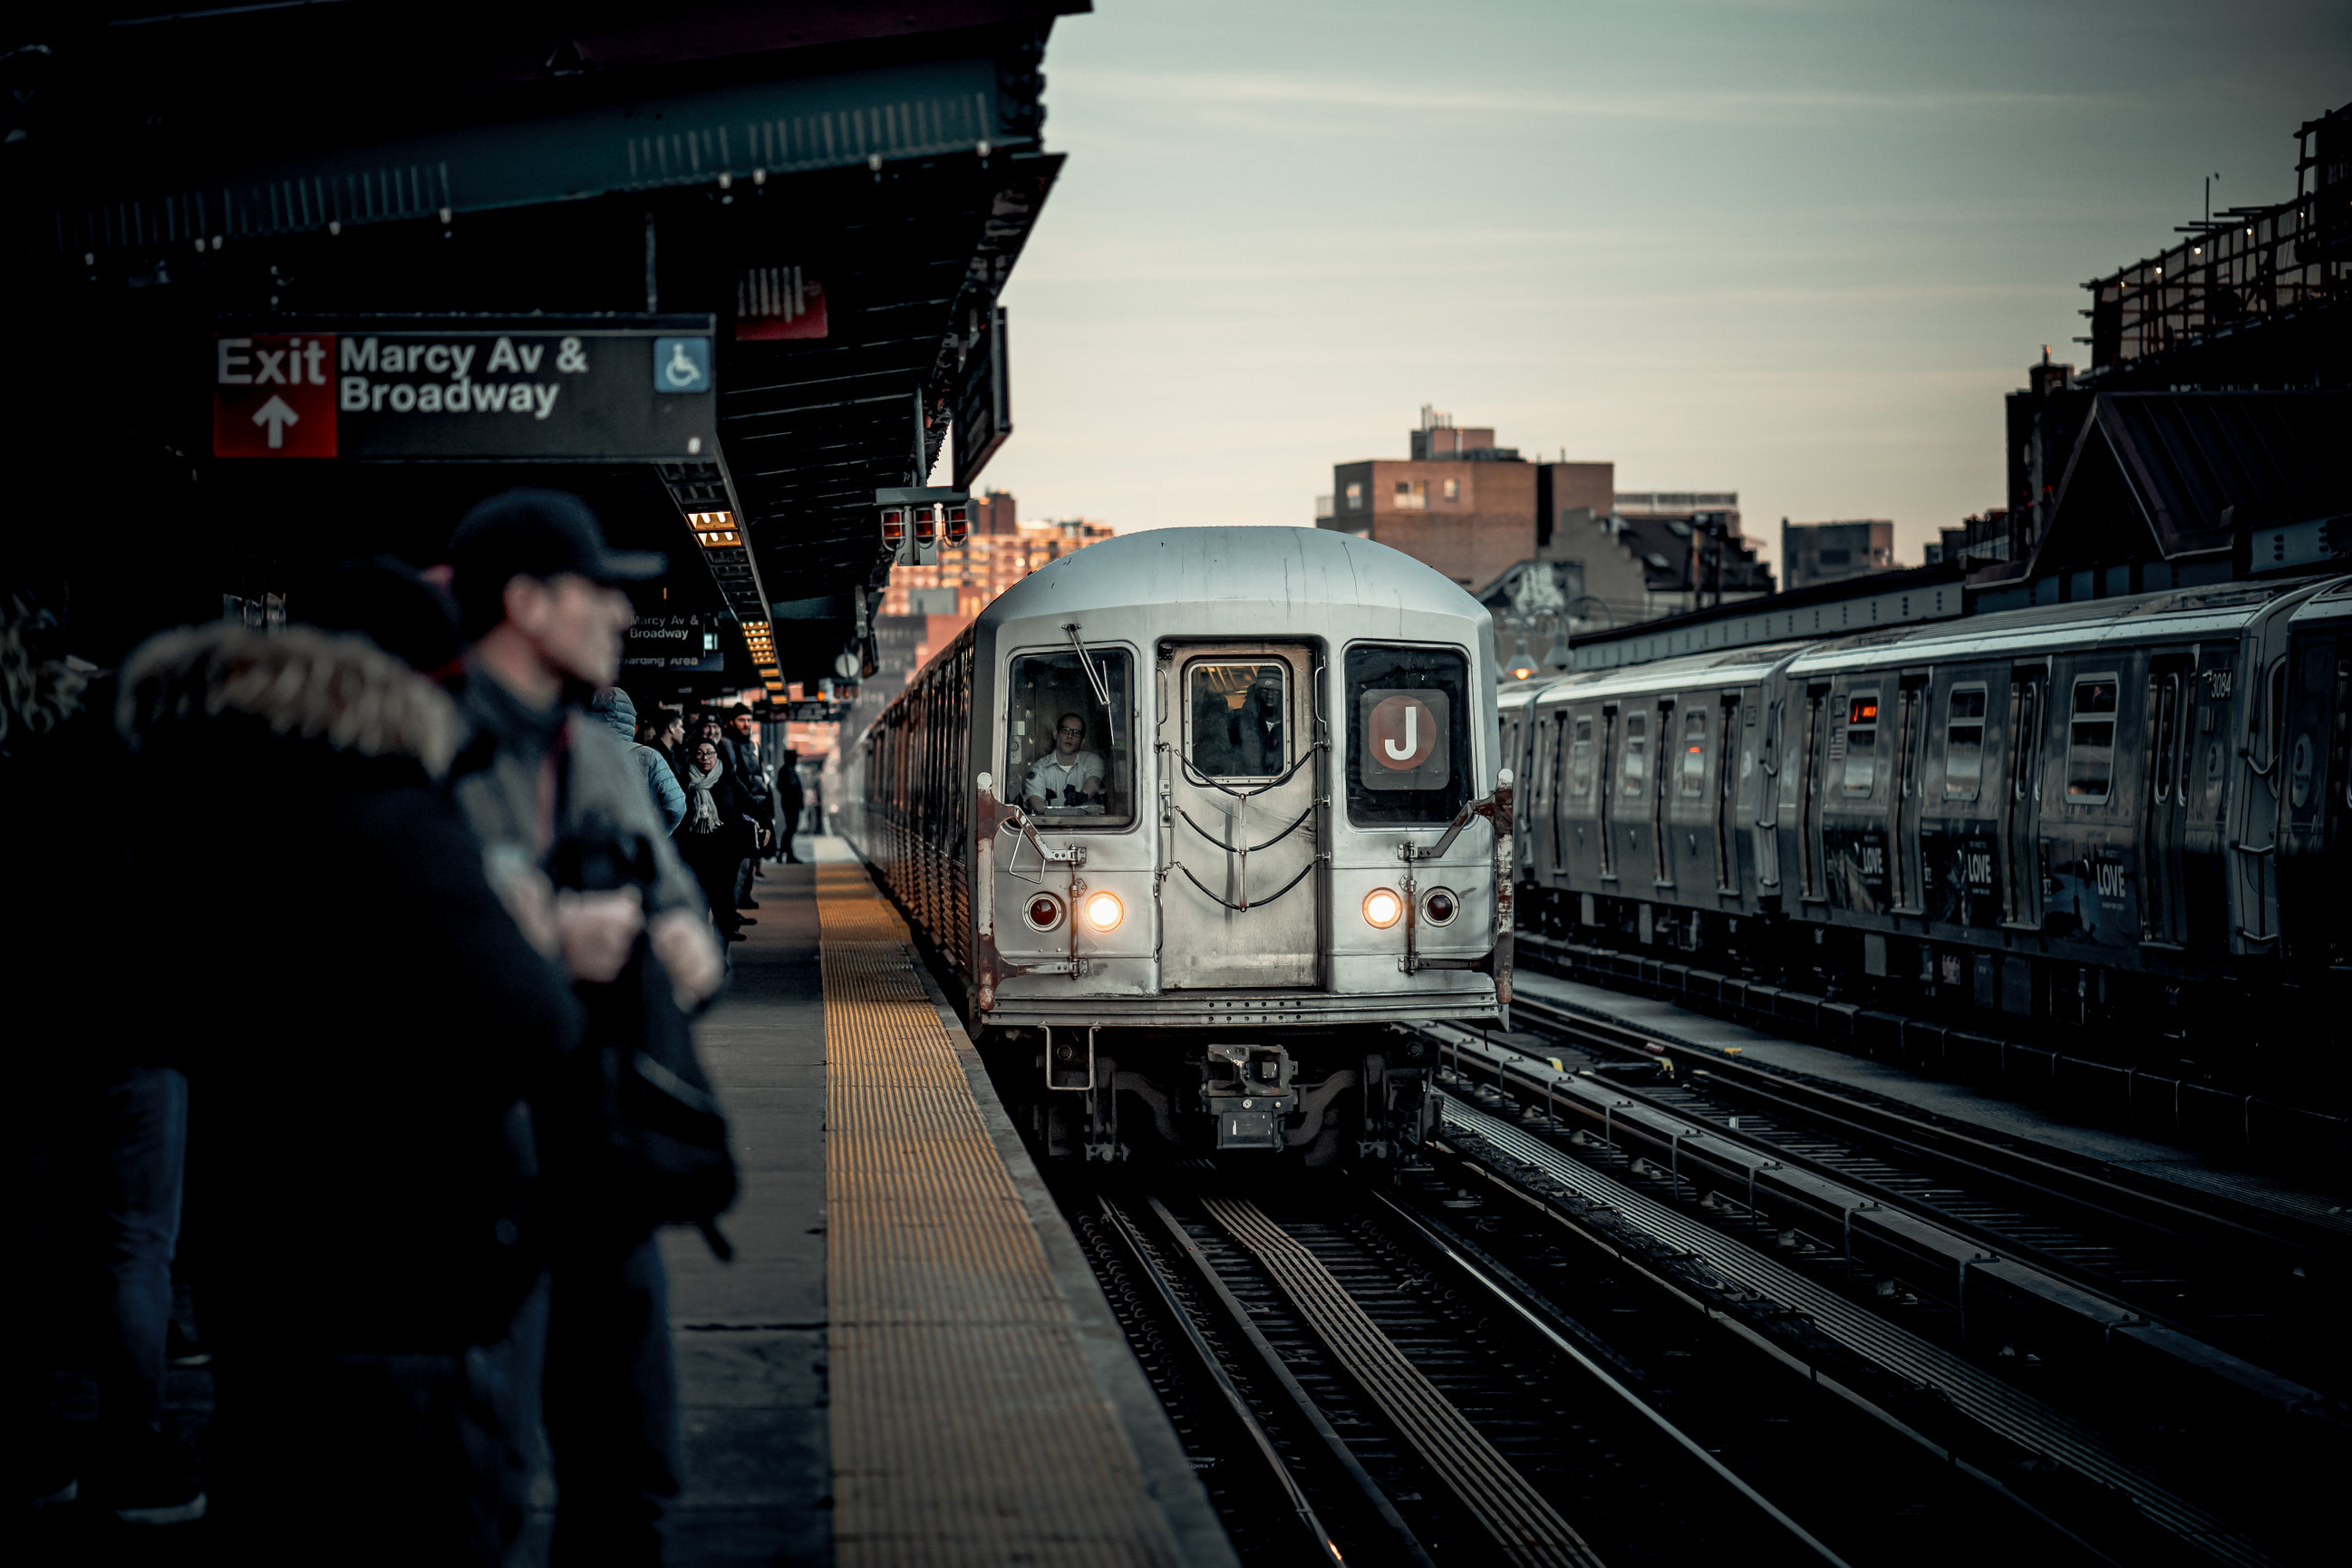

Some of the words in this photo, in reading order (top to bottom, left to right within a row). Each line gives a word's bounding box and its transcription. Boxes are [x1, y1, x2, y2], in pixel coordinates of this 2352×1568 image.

[218, 336, 327, 386] Exit
[340, 336, 477, 380] Marcy
[487, 336, 544, 373] Av
[556, 336, 588, 373] &
[340, 376, 560, 421] Broadway
[629, 628, 689, 640] Broadway
[630, 615, 666, 627] Marcy
[671, 615, 685, 625] Av
[690, 615, 699, 625] &
[621, 656, 665, 668] oarding
[670, 656, 699, 666] Area
[2211, 672, 2232, 699] 3084
[1384, 706, 1418, 761] J
[1862, 846, 1884, 876] LOVE
[1967, 853, 1992, 885] LOVE
[2096, 863, 2126, 898] LOVE
